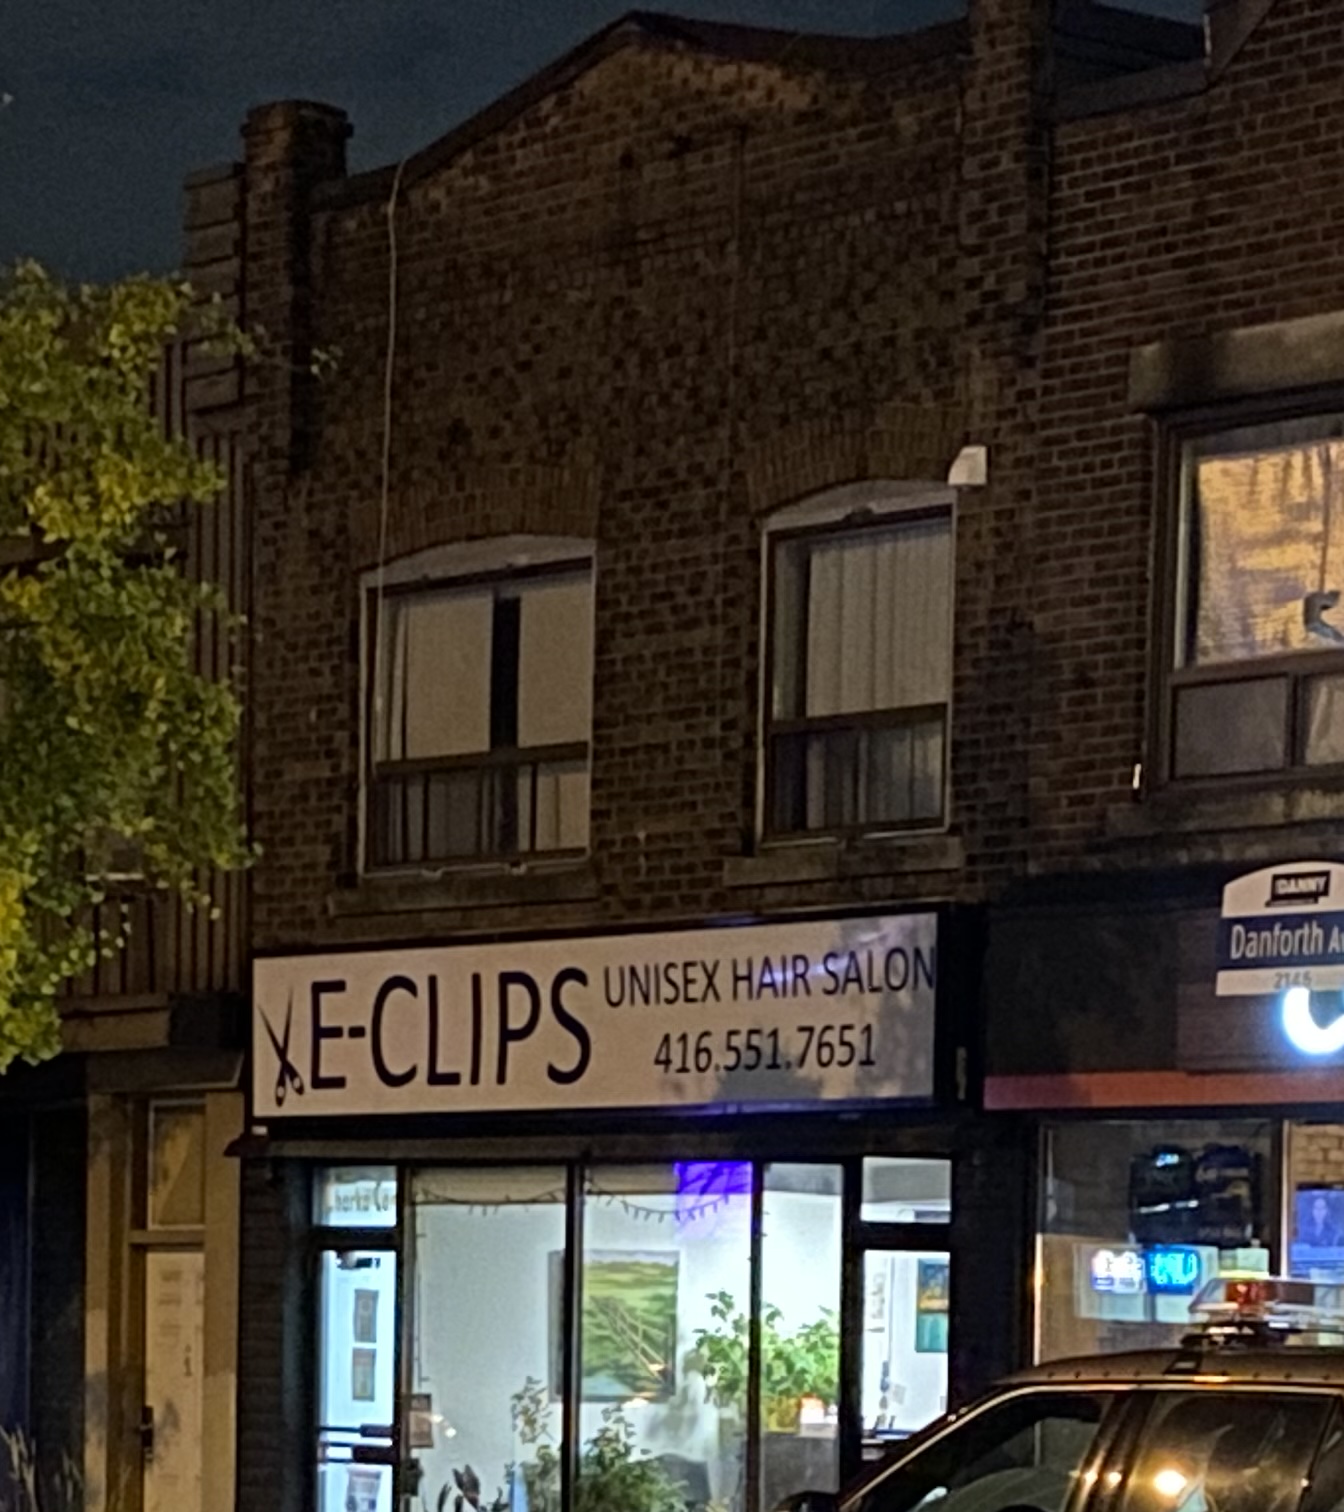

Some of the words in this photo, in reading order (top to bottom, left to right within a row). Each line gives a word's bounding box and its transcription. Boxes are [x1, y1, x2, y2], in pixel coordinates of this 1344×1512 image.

[1230, 920, 1324, 960] Danforth
[604, 958, 721, 1008] UNISEX
[732, 953, 812, 1000] HAIR
[821, 945, 935, 995] SALON
[310, 966, 592, 1089] E-CLIPS
[654, 1022, 877, 1075] 416.551.7651
